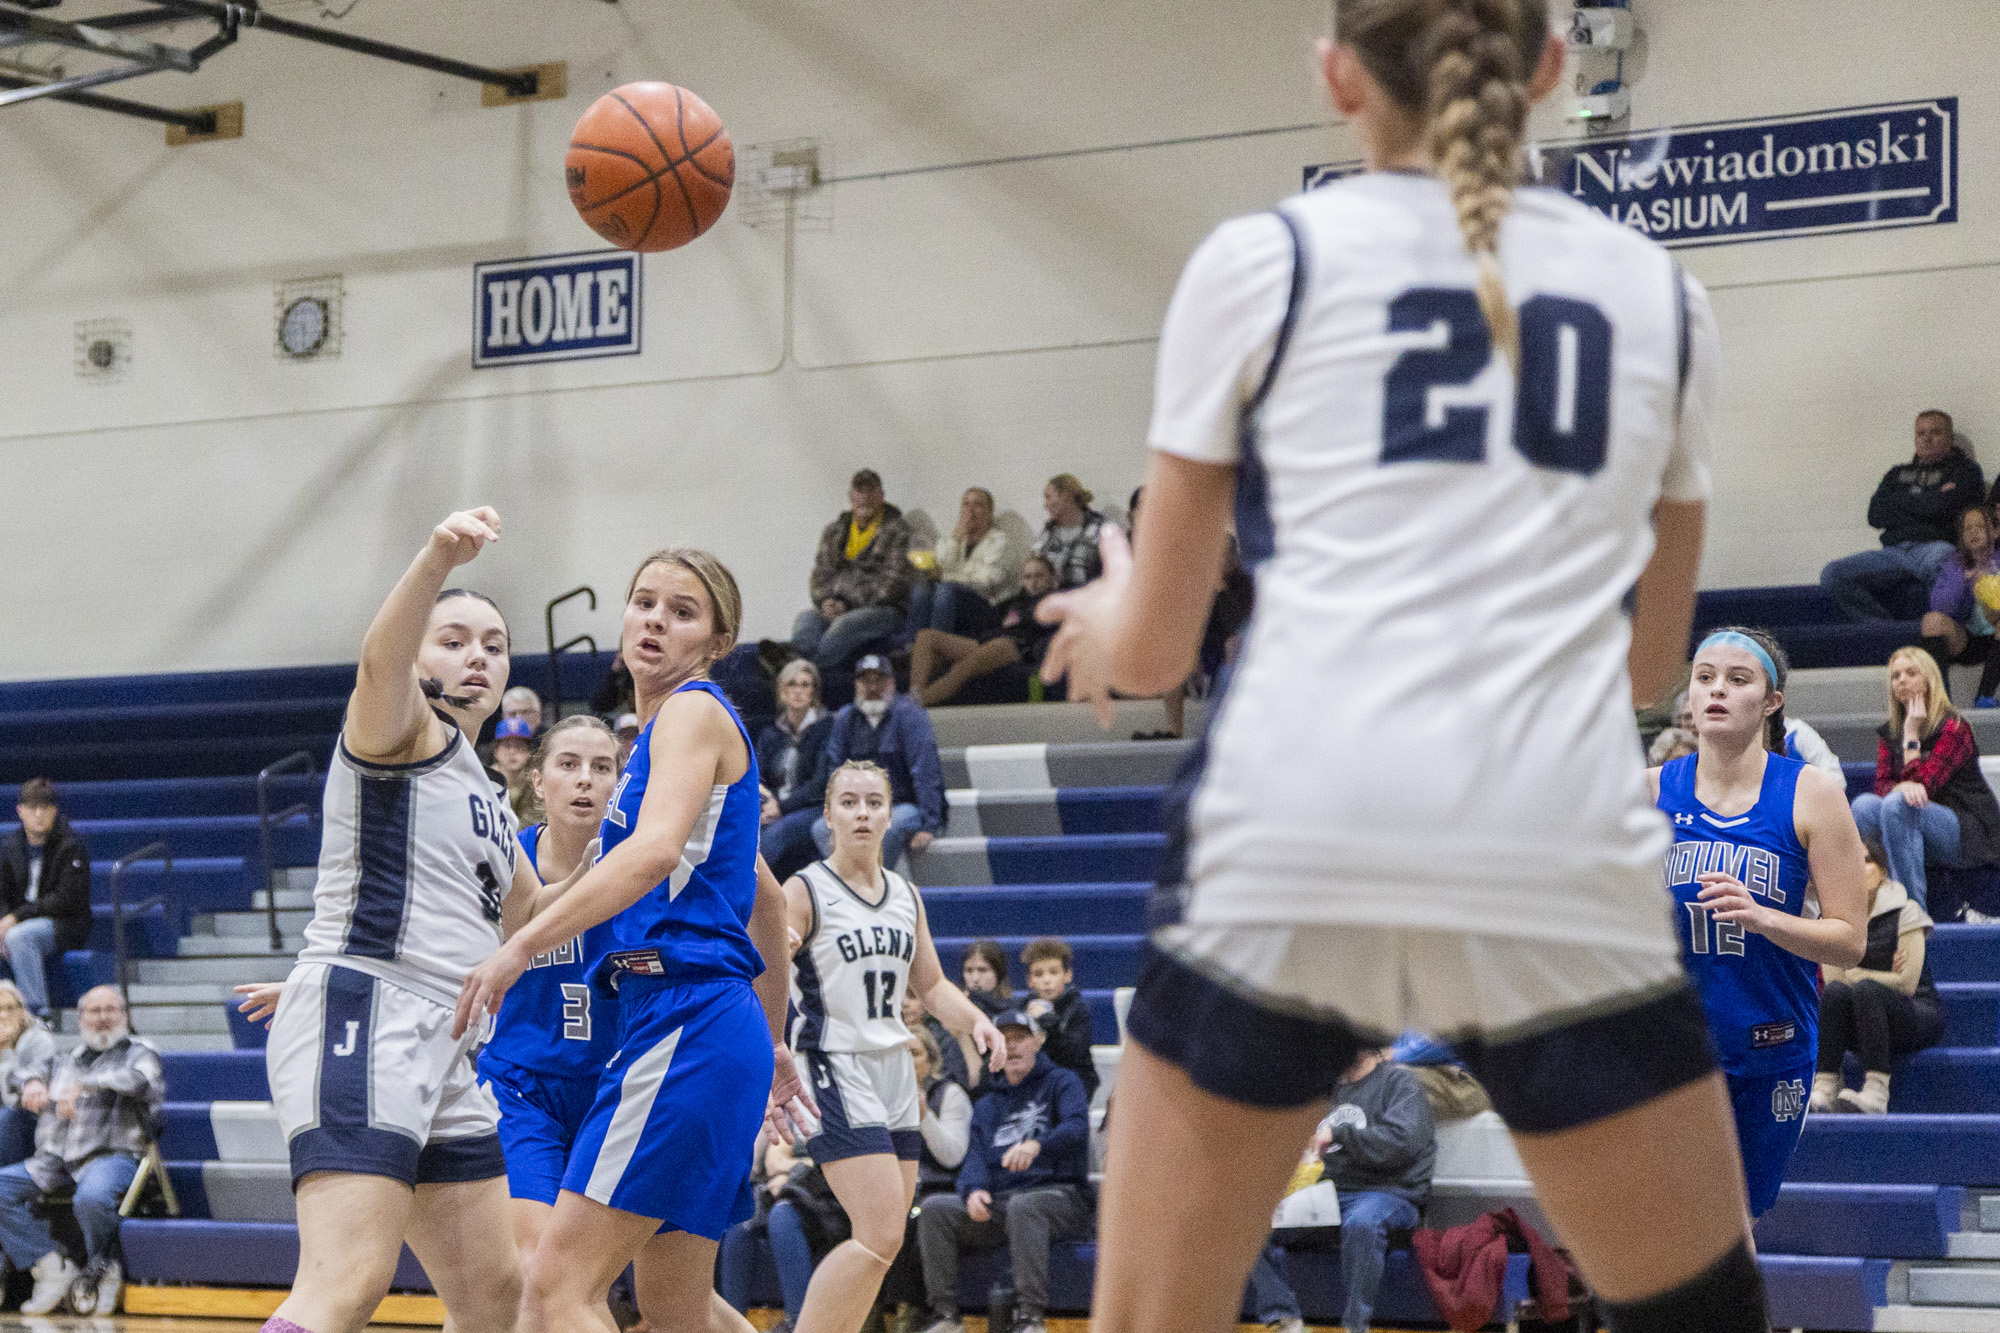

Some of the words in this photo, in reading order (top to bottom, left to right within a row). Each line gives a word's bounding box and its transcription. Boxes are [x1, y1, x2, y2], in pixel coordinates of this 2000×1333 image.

[1573, 117, 1929, 196] Niewiadomski
[487, 268, 628, 347] HOME
[1379, 287, 1614, 476] 20
[837, 926, 914, 964] GLENN
[1684, 902, 1745, 957] 12
[560, 983, 591, 1041] 3
[864, 970, 896, 1020] 12
[333, 1021, 360, 1057] J
